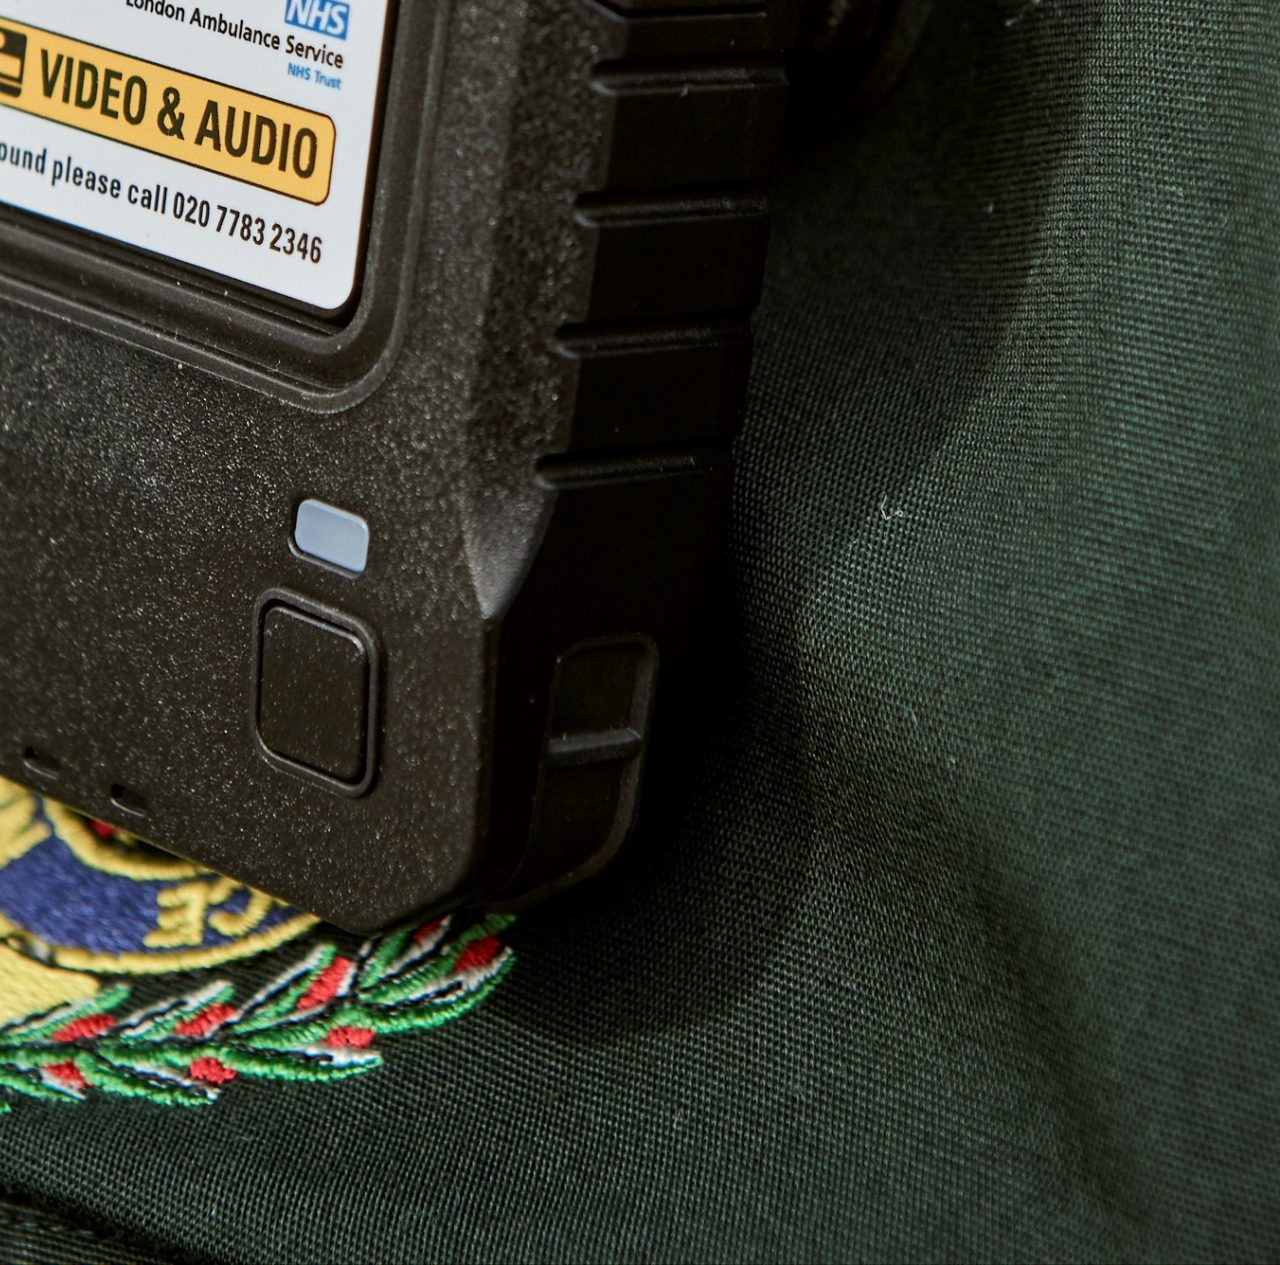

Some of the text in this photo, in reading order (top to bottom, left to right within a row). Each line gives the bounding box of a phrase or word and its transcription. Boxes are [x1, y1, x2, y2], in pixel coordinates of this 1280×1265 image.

[190, 7, 280, 50] Ambulance
[285, 35, 344, 69] Service
[288, 62, 342, 89] NHS Trust
[40, 48, 318, 179] VIDEO & AUDIO
[52, 156, 121, 199] please
[127, 184, 168, 215] call
[173, 191, 210, 228] 020
[216, 204, 266, 246] 7783
[270, 222, 323, 264] 2346
